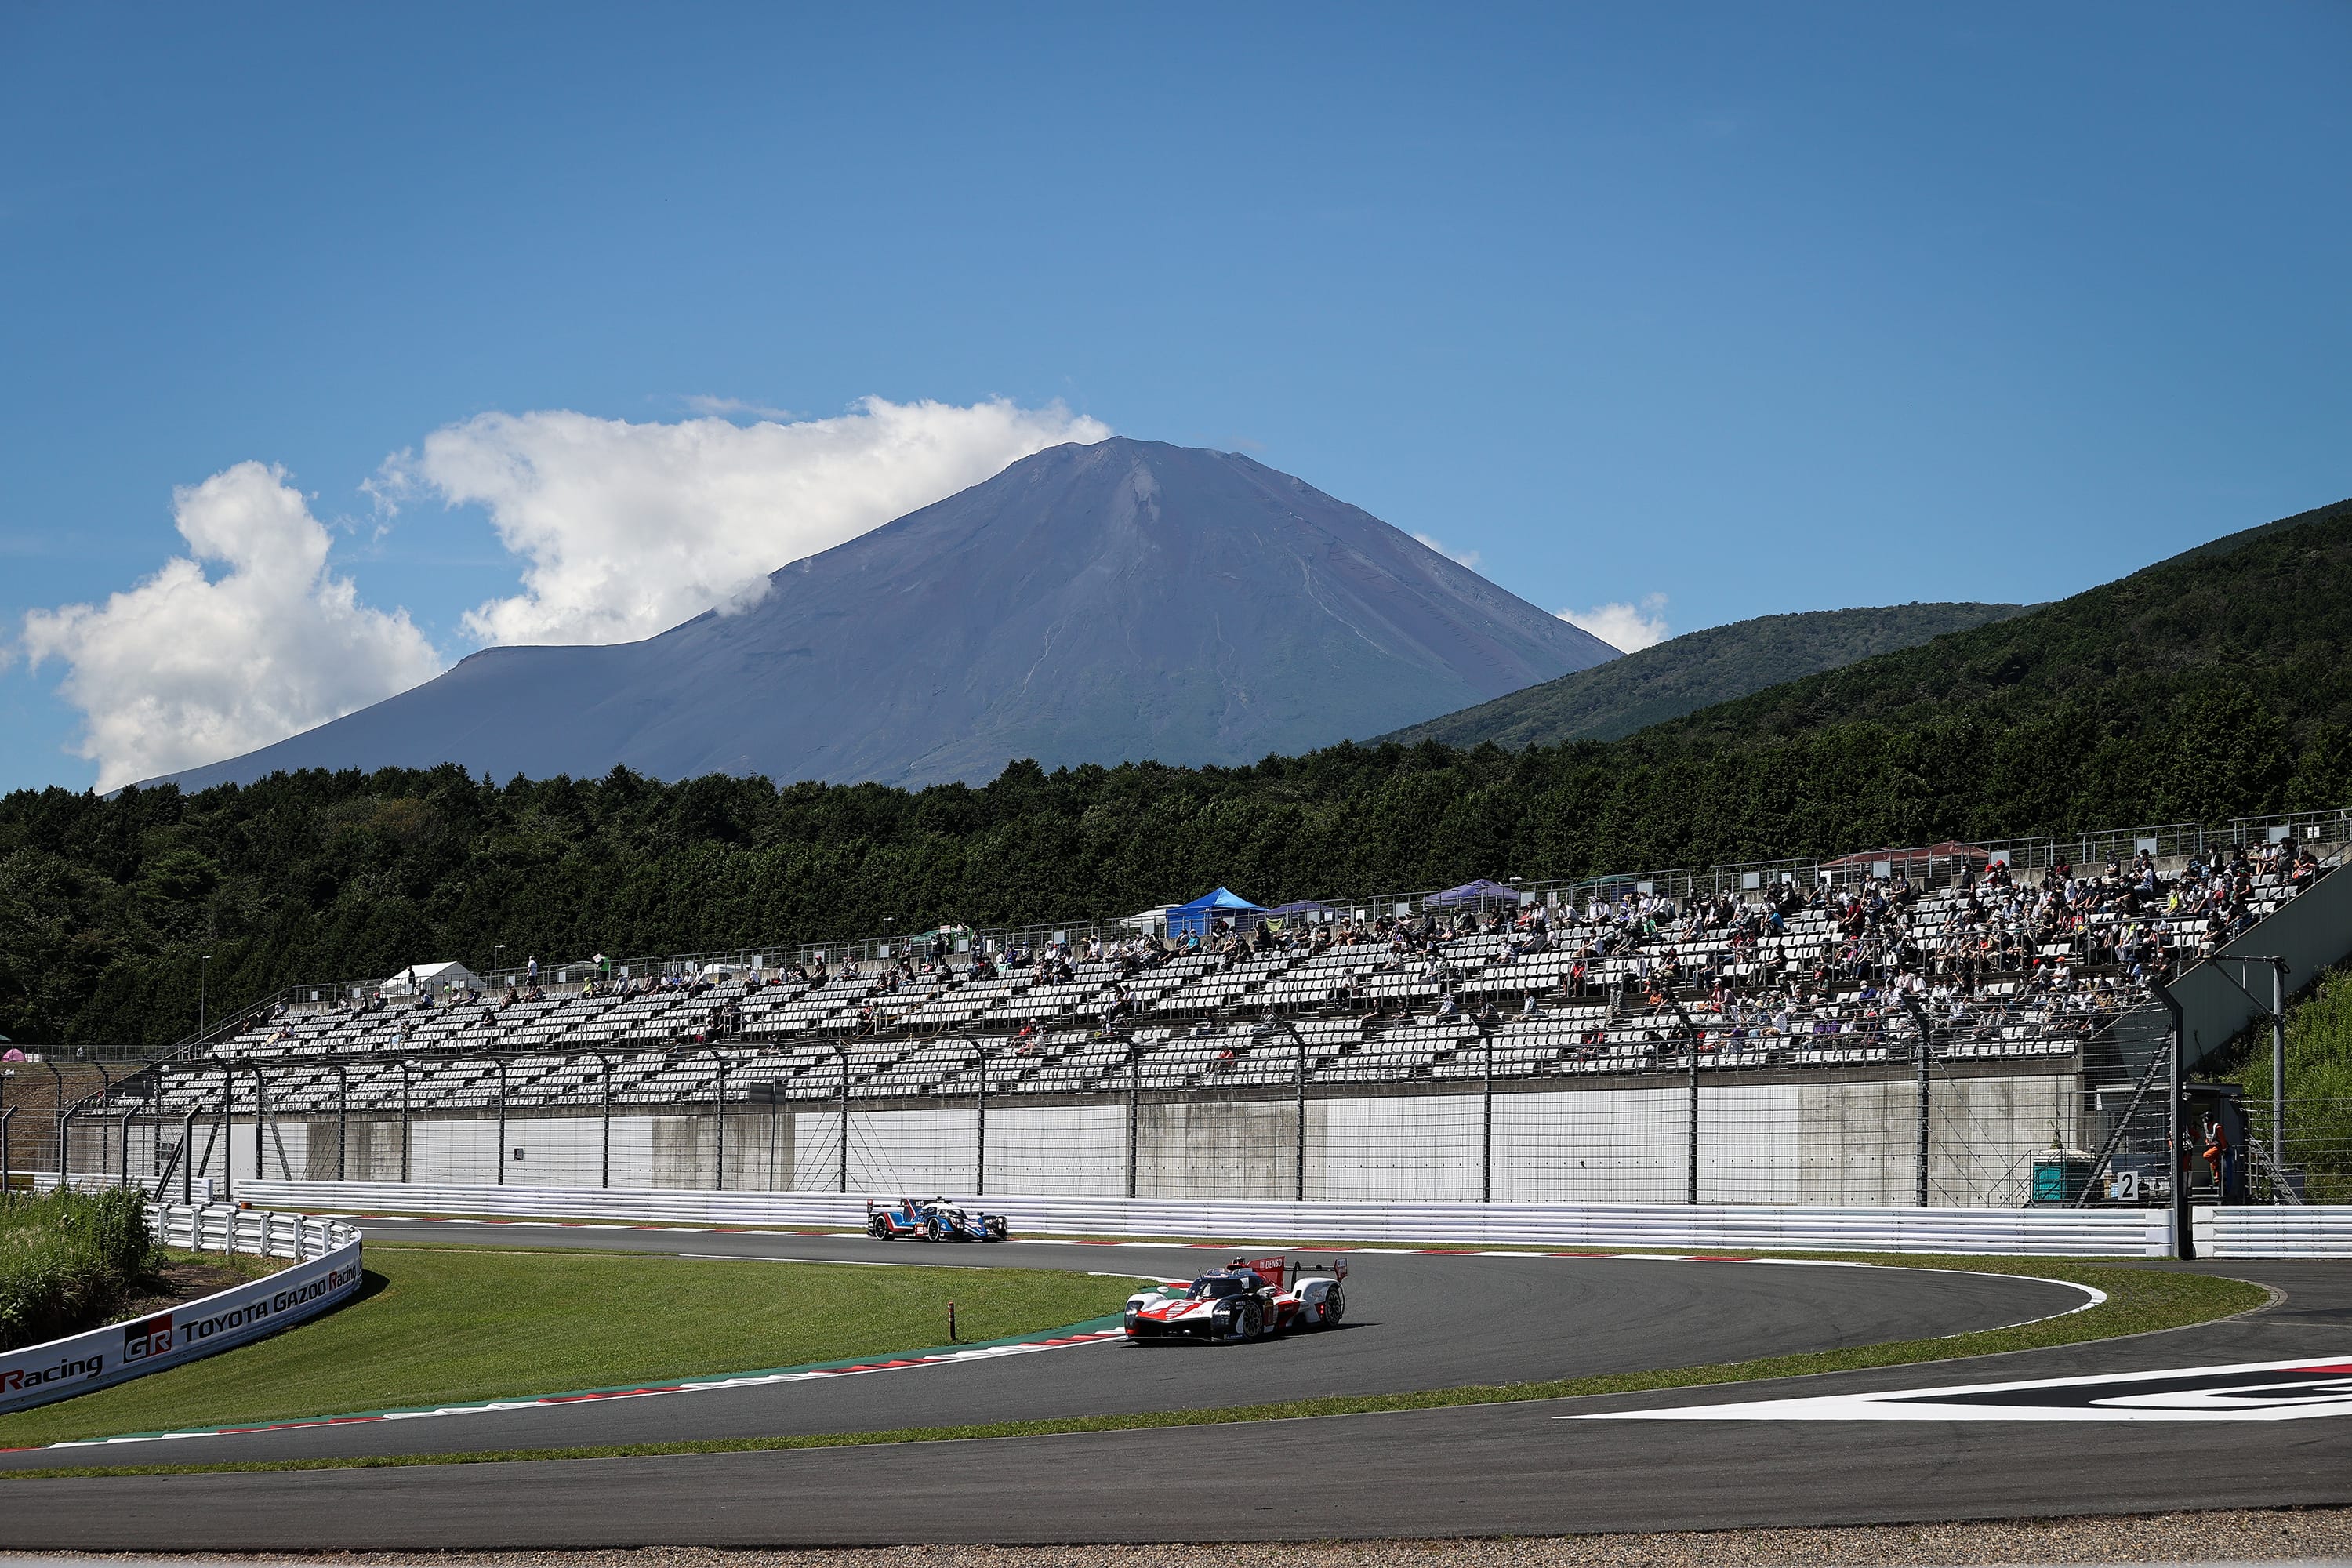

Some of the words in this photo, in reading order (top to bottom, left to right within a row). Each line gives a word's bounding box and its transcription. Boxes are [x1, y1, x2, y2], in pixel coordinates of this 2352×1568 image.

[2122, 1174, 2134, 1198] 2
[1265, 1258, 1283, 1269] DENSO
[125, 1329, 172, 1361] GR
[180, 1301, 268, 1343] TOYOTA
[274, 1279, 326, 1313] GAZOO
[329, 1264, 357, 1292] Racing
[0, 1354, 103, 1394] Racing
